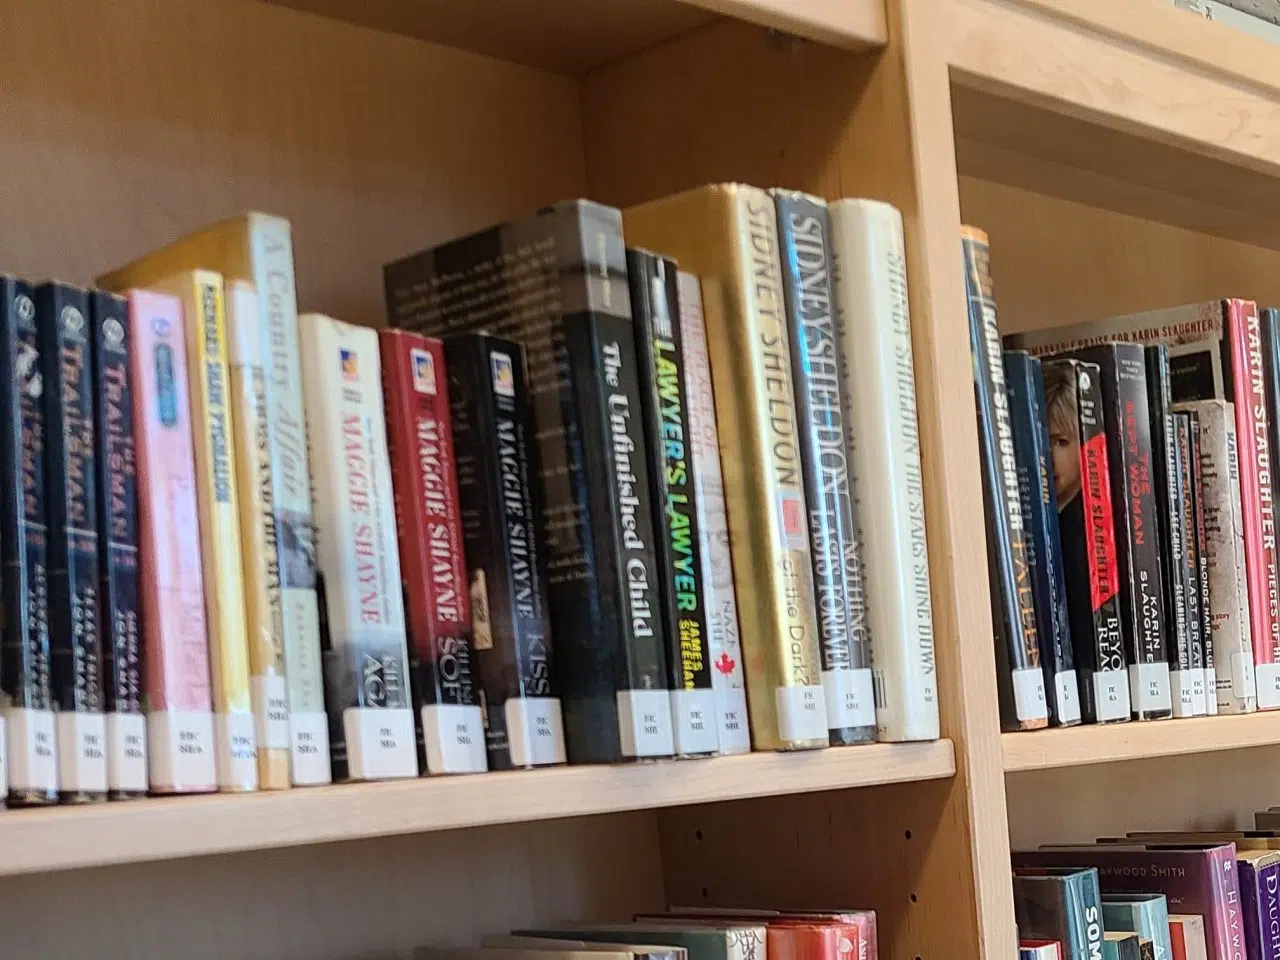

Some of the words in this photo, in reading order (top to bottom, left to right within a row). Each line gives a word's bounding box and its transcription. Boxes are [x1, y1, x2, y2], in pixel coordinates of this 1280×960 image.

[748, 201, 781, 321] SIDNEY
[789, 212, 833, 333] SIDNEY
[603, 340, 623, 389] The
[895, 345, 921, 454] SHELDON
[1247, 315, 1265, 395] KARIN
[654, 338, 687, 487] LAWYER'S
[760, 333, 797, 488] SHELDON
[805, 334, 850, 496] SHELDON
[1125, 400, 1138, 453] KEPT
[342, 414, 369, 514] MAGGIE
[416, 418, 447, 516] MAGGIE
[496, 418, 524, 516] MAGGIE
[608, 394, 645, 550] Unfinished
[904, 461, 922, 496] THE
[982, 304, 1005, 391] KARIN
[994, 394, 1024, 530] SLAUGHTER
[1011, 540, 1041, 669] FALLEN
[1129, 463, 1145, 545] WOMAN
[1253, 403, 1276, 551] SLAUGHTER
[355, 523, 382, 625] SHAYNE
[429, 523, 459, 622] SHAYNE
[507, 521, 535, 619] SHAYNE
[667, 493, 697, 612] LAWYER
[907, 501, 925, 560] STARS
[626, 557, 653, 637] Child
[842, 540, 868, 643] NOTHING
[911, 563, 929, 618] SHINE
[1139, 570, 1155, 662] SLAUGHTE
[1149, 596, 1161, 650] KARIN
[1267, 563, 1280, 618] PIECES
[1271, 622, 1280, 639] OF
[689, 618, 703, 672] JAMES
[917, 621, 934, 676] DOWN
